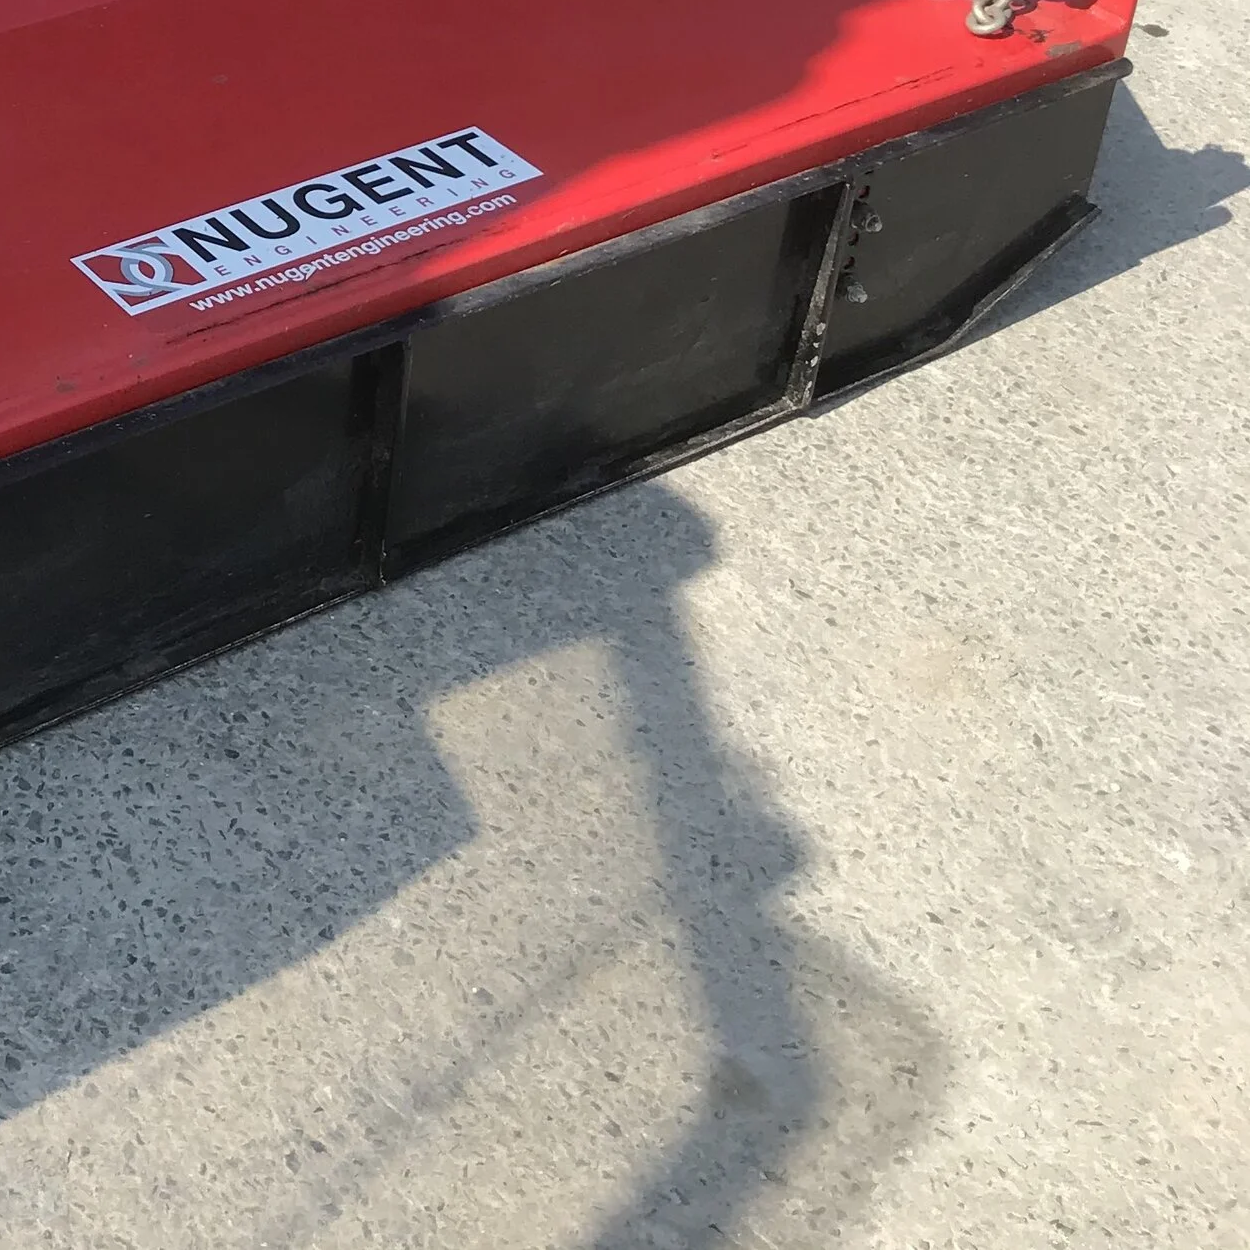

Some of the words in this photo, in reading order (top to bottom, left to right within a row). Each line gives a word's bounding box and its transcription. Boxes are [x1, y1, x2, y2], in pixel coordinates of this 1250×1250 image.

[171, 131, 499, 263] NUGENT
[189, 191, 517, 313] www.nugentengineering.com
[217, 169, 516, 277] ENGINEERING
